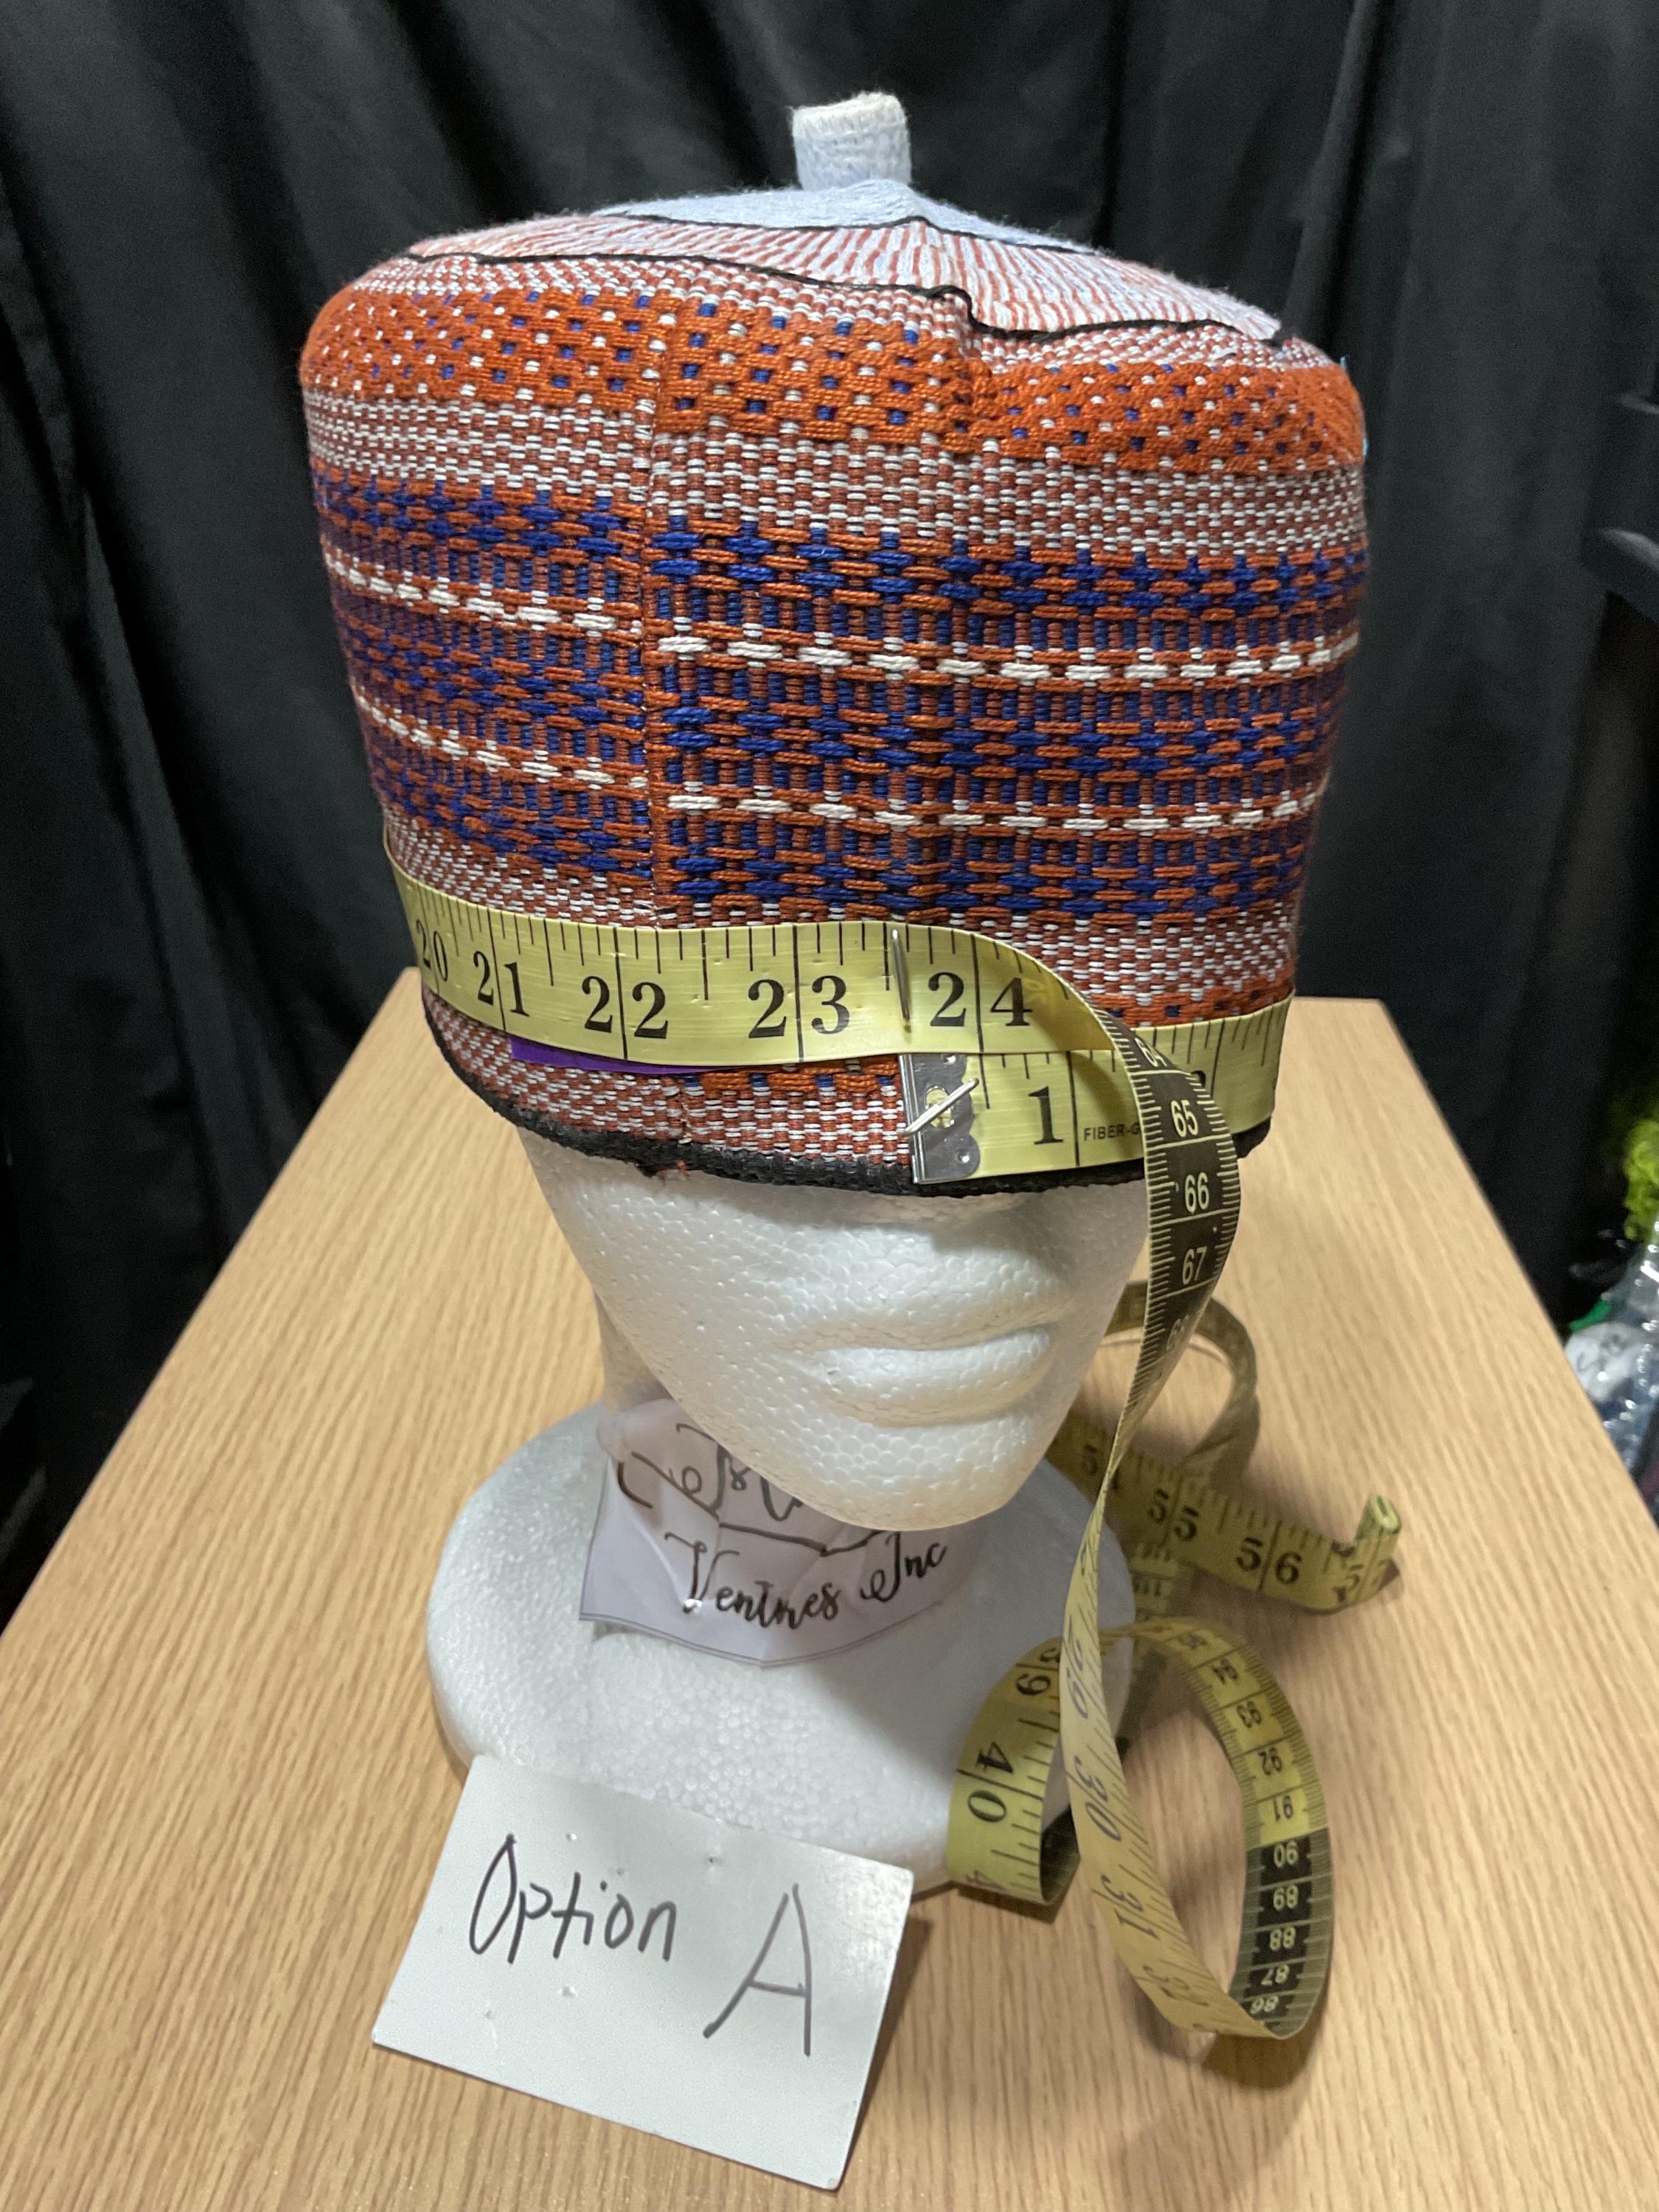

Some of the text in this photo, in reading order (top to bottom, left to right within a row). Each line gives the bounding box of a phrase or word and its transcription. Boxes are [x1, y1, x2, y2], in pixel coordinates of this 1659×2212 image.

[473, 950, 529, 1018] 21
[581, 975, 669, 1040] 22
[747, 975, 851, 1038] 23
[928, 971, 1033, 1027] 24
[1028, 1086, 1064, 1145] 1
[1170, 1099, 1199, 1138] 65
[1184, 1172, 1209, 1214] 66
[1182, 1247, 1208, 1285] 67
[1150, 1488, 1200, 1541] 55
[1236, 1537, 1303, 1585] 56
[1259, 1746, 1283, 1776] 92
[968, 1742, 1014, 1823] 40
[1273, 1795, 1293, 1822] 91
[1273, 1841, 1298, 1868] 90
[1273, 1885, 1298, 1910] 89
[469, 1833, 811, 2057] Option A
[1270, 1926, 1295, 1951] 88
[1261, 1964, 1289, 1986] 87
[1250, 1995, 1279, 2014] 86
